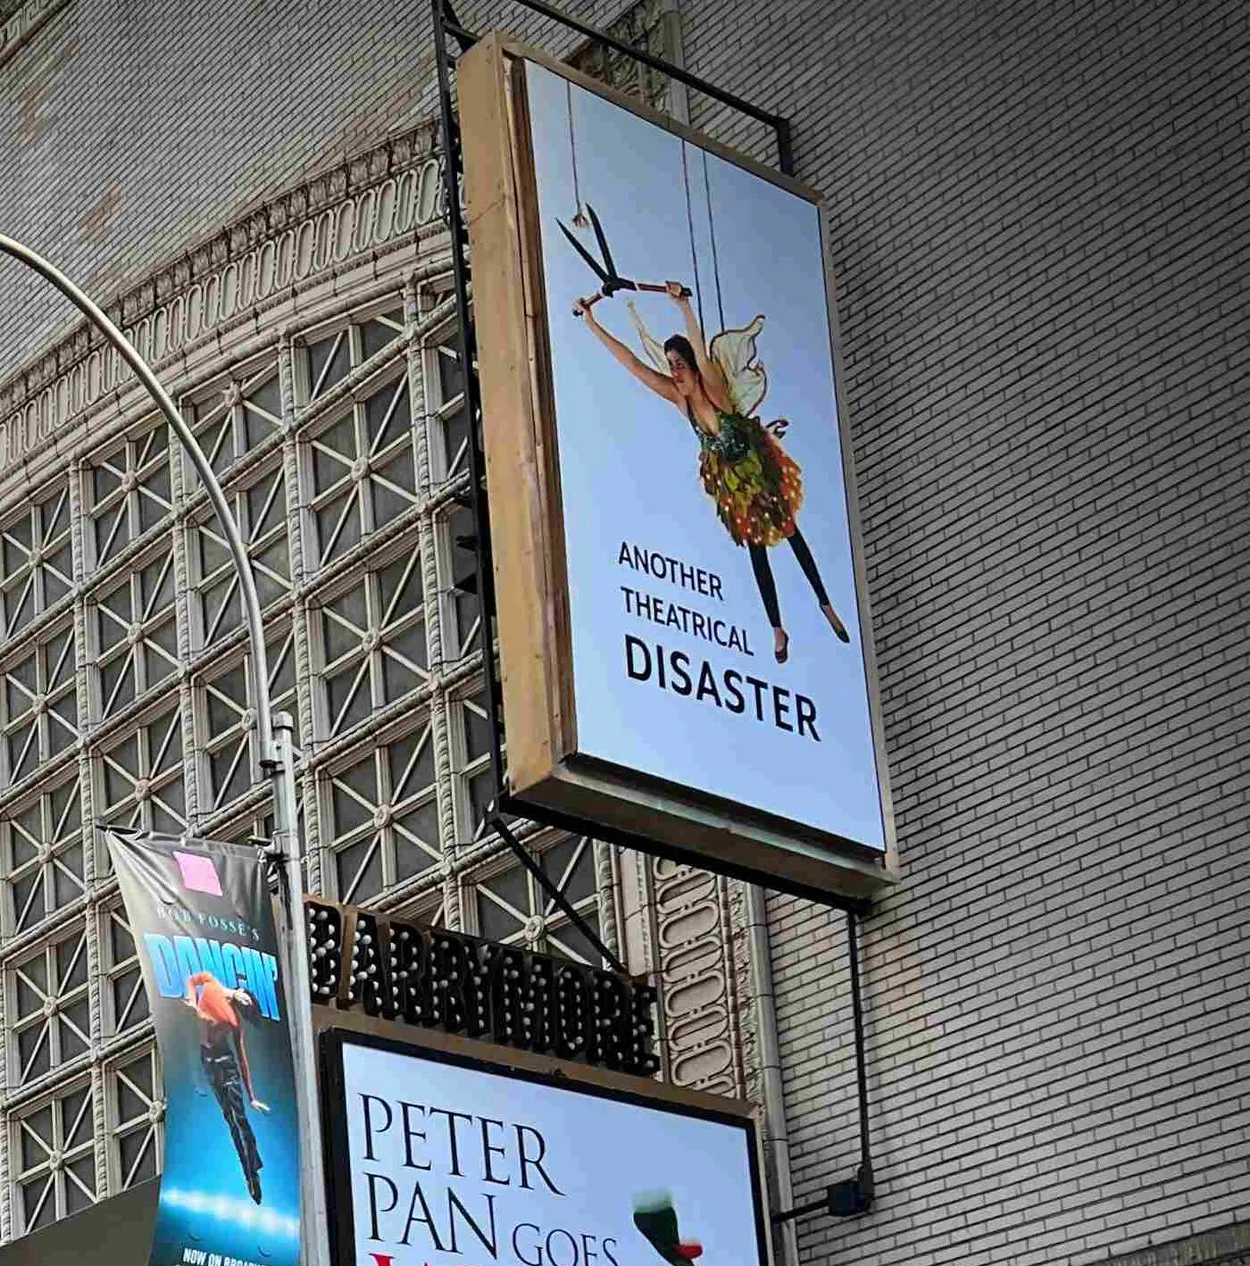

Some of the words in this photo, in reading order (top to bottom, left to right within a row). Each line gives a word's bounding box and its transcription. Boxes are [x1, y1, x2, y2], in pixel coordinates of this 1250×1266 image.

[619, 541, 724, 601] ANOTHER
[621, 586, 754, 656] THEATRICAL
[625, 634, 821, 742] DISASTER
[198, 912, 260, 943] FOSSE'S
[357, 1093, 565, 1196] PETER
[363, 1172, 498, 1259] PAN
